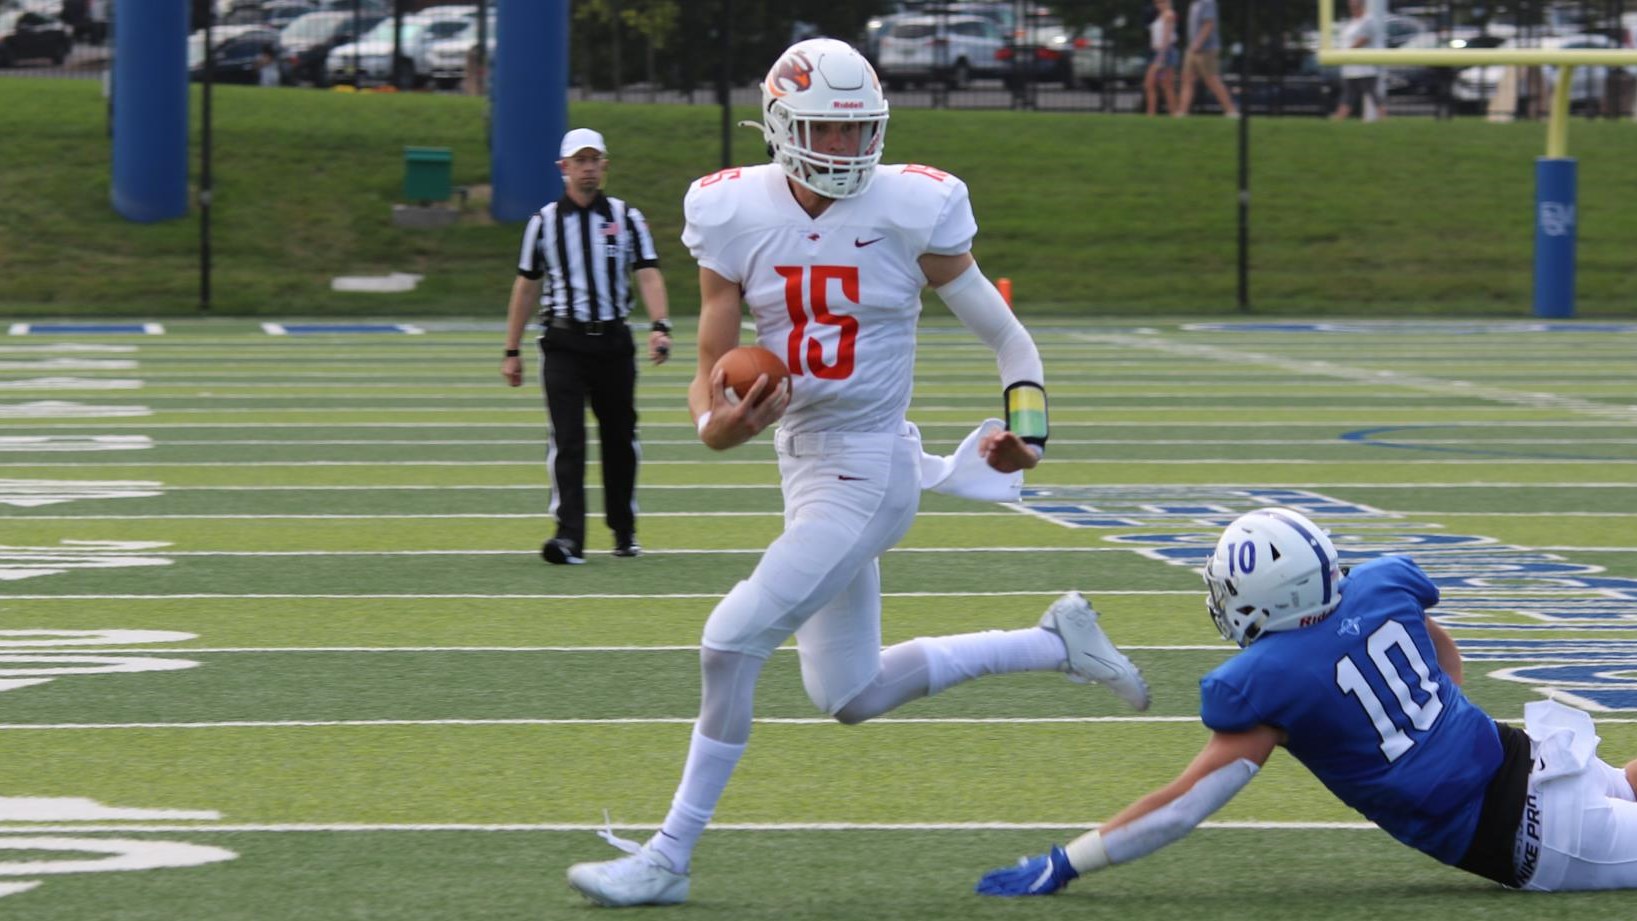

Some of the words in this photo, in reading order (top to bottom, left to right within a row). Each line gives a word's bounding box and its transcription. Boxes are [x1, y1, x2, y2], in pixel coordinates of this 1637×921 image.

[833, 101, 864, 109] Riddell
[774, 265, 860, 380] 15
[1228, 540, 1256, 577] 10
[1336, 618, 1444, 765] 10
[1516, 841, 1539, 886] NIKE
